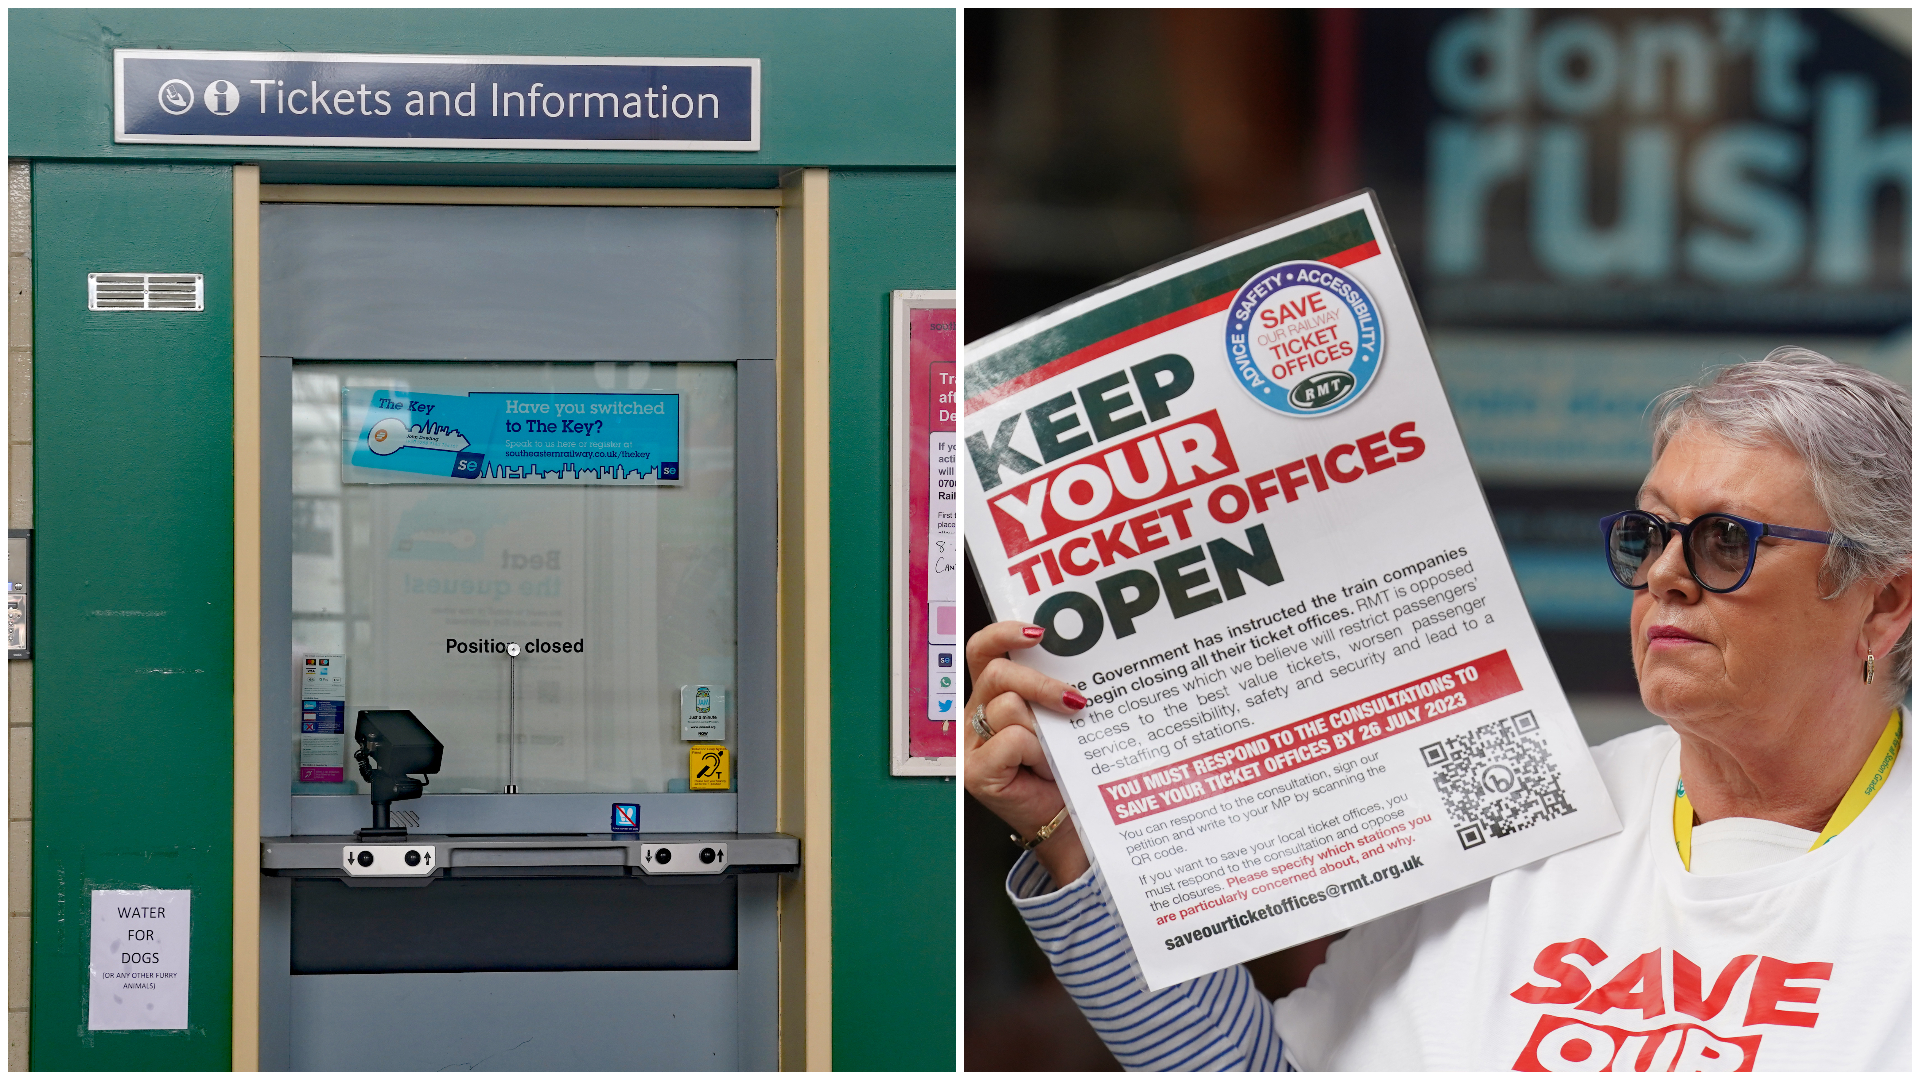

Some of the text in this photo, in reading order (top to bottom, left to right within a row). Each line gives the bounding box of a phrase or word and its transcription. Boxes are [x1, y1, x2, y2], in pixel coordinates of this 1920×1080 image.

[250, 79, 719, 119] Tickets and Information
[1425, 77, 1912, 283] rush
[1235, 269, 1376, 353] SAFETY ACCESSIBILITY
[1257, 308, 1340, 346] OUR RAILWAY
[1260, 291, 1326, 329] SAVE
[1231, 334, 1266, 388] ADVICE
[1269, 325, 1338, 360] TICKET
[1272, 341, 1353, 380] OFFICES
[378, 398, 436, 416] The Key
[506, 400, 665, 417] Have you switched
[1305, 378, 1341, 401] RMT
[506, 419, 603, 436] to The Key?
[964, 353, 1195, 492] KEEP
[505, 440, 622, 450] Speak here register
[505, 450, 651, 459] southeasternrailway.co.uk/thekey
[457, 459, 478, 472] se
[663, 467, 677, 475] se
[938, 467, 954, 476] will
[938, 479, 956, 488] 070
[993, 422, 1228, 542] YOUR
[1007, 421, 1426, 595] TICKET OFFICES
[1033, 523, 1284, 657] OPEN
[1091, 546, 1468, 686] Government has instructed the train companies
[1130, 664, 1188, 691] closing
[1190, 653, 1209, 671] all
[1210, 642, 1246, 663] their
[1248, 624, 1295, 649] ticket
[1297, 607, 1354, 633] offices.
[1355, 588, 1390, 612] RMT
[1409, 559, 1474, 593] opposed
[446, 638, 584, 654] Positio closed
[1088, 708, 1114, 724] the
[1117, 686, 1180, 715] closures
[1182, 668, 1227, 692] which
[1254, 641, 1308, 667] believe
[1310, 627, 1336, 646] will
[1338, 610, 1390, 638] restrict
[1392, 576, 1477, 622] passengers’
[1077, 596, 1486, 745] access the best value tickets, worsen passenger
[1083, 613, 1495, 760] service, accessibility, safety and security and lead a
[1090, 717, 1255, 776] de-staffing stations.
[1105, 673, 1455, 800] YOU MUST RESPOND THE CONSULTATIONS
[1115, 691, 1467, 819] SAVE YOUR TICKET OFFICES JULY 2023
[716, 772, 722, 780] T
[1878, 752, 1893, 774] Station
[1145, 751, 1379, 834] can respond the consultation, sign our
[1864, 774, 1882, 796] Grades
[1125, 764, 1386, 856] petition write your scanning the
[1153, 844, 1187, 860] code.
[1173, 793, 1408, 874] want save your local ticket offices, you
[1144, 809, 1405, 899] must respond consultation and oppose
[1172, 813, 1432, 905] closures. Please specify which stations you
[1178, 835, 1416, 920] particularly concerned about, why.
[118, 906, 166, 919] WATER
[1164, 854, 1425, 951] saveourticketoffices@rmt.org.uk
[128, 930, 154, 941] FOR
[102, 972, 114, 980] (OR
[121, 952, 160, 964] DOGS
[122, 982, 156, 990] ANIMALS)
[1510, 938, 1834, 1028] SAVE
[1536, 1022, 1746, 1072] OUR
